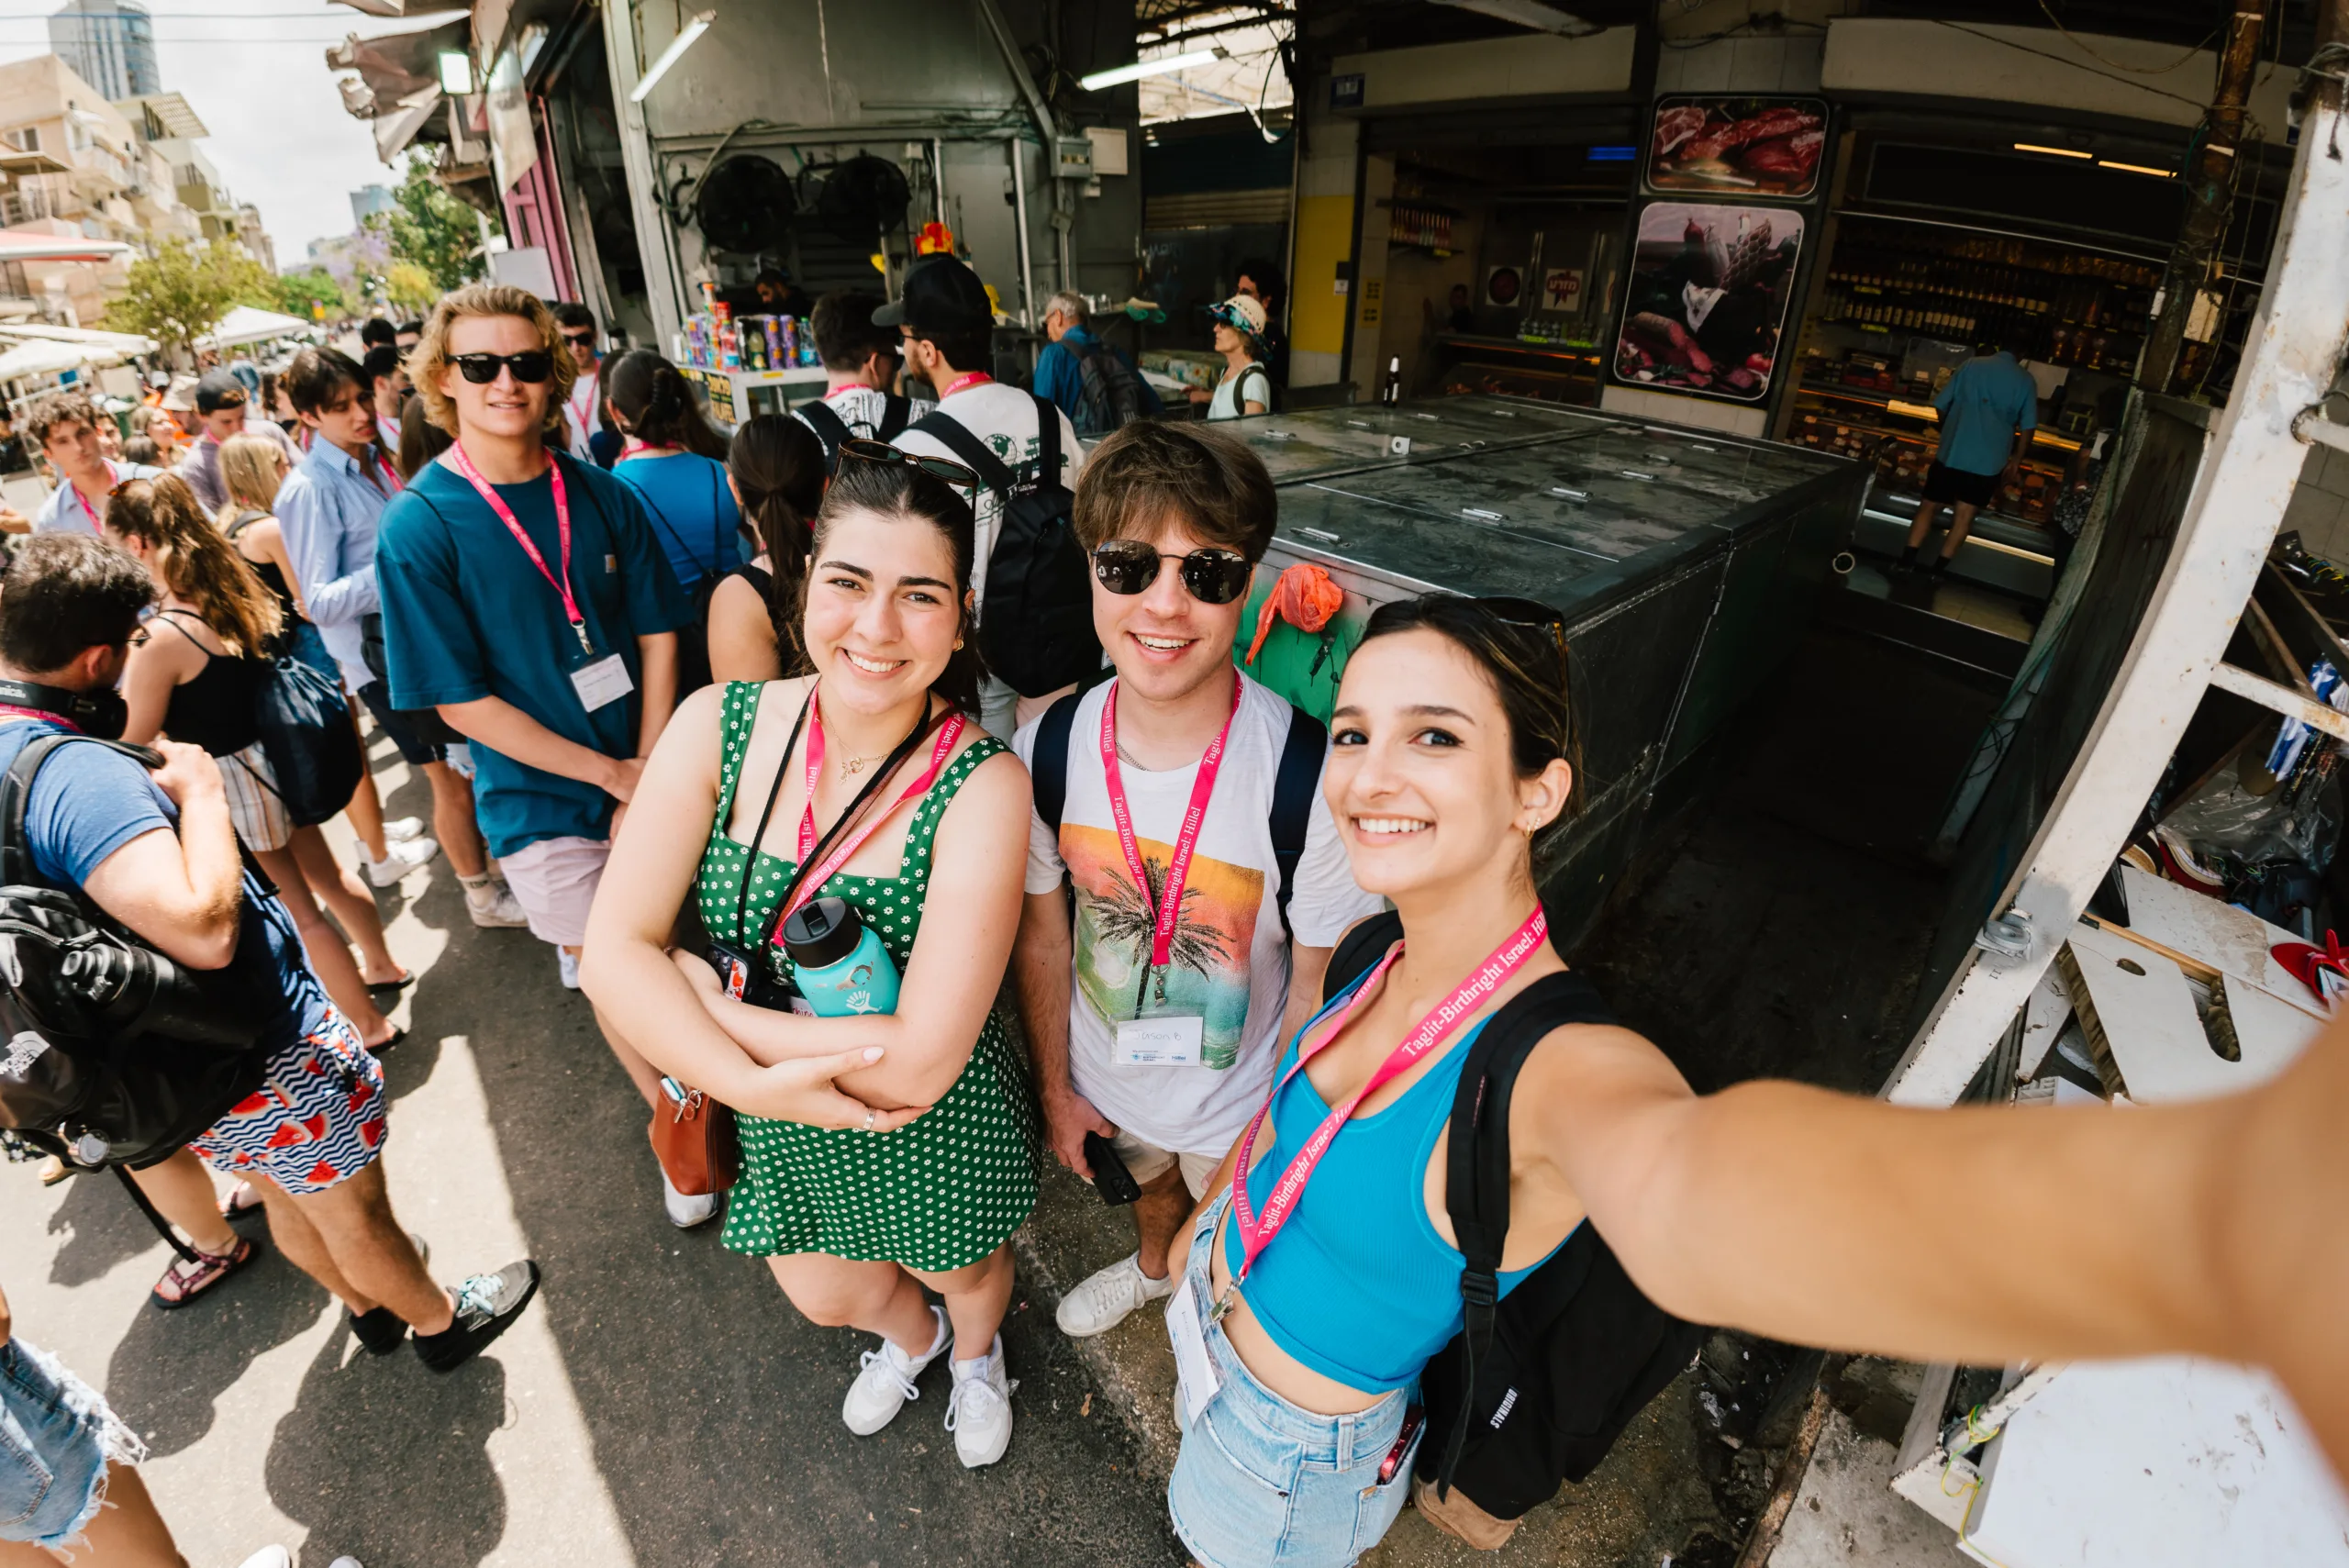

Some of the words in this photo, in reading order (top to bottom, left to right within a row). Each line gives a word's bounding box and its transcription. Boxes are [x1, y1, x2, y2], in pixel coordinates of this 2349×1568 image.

[1114, 795, 1141, 874] Taglit-Birthright
[1159, 867, 1183, 937] Taglit-Birthright
[1174, 836, 1192, 867] Israel:
[1184, 806, 1201, 836] Hillel
[1401, 963, 1504, 1057] Taglit-Birthright
[1497, 930, 1536, 969] Israel:
[1237, 1189, 1253, 1229] Hillel
[1257, 1156, 1310, 1238] Taglit-Birthright
[1490, 1388, 1518, 1429] ORIGINALS
